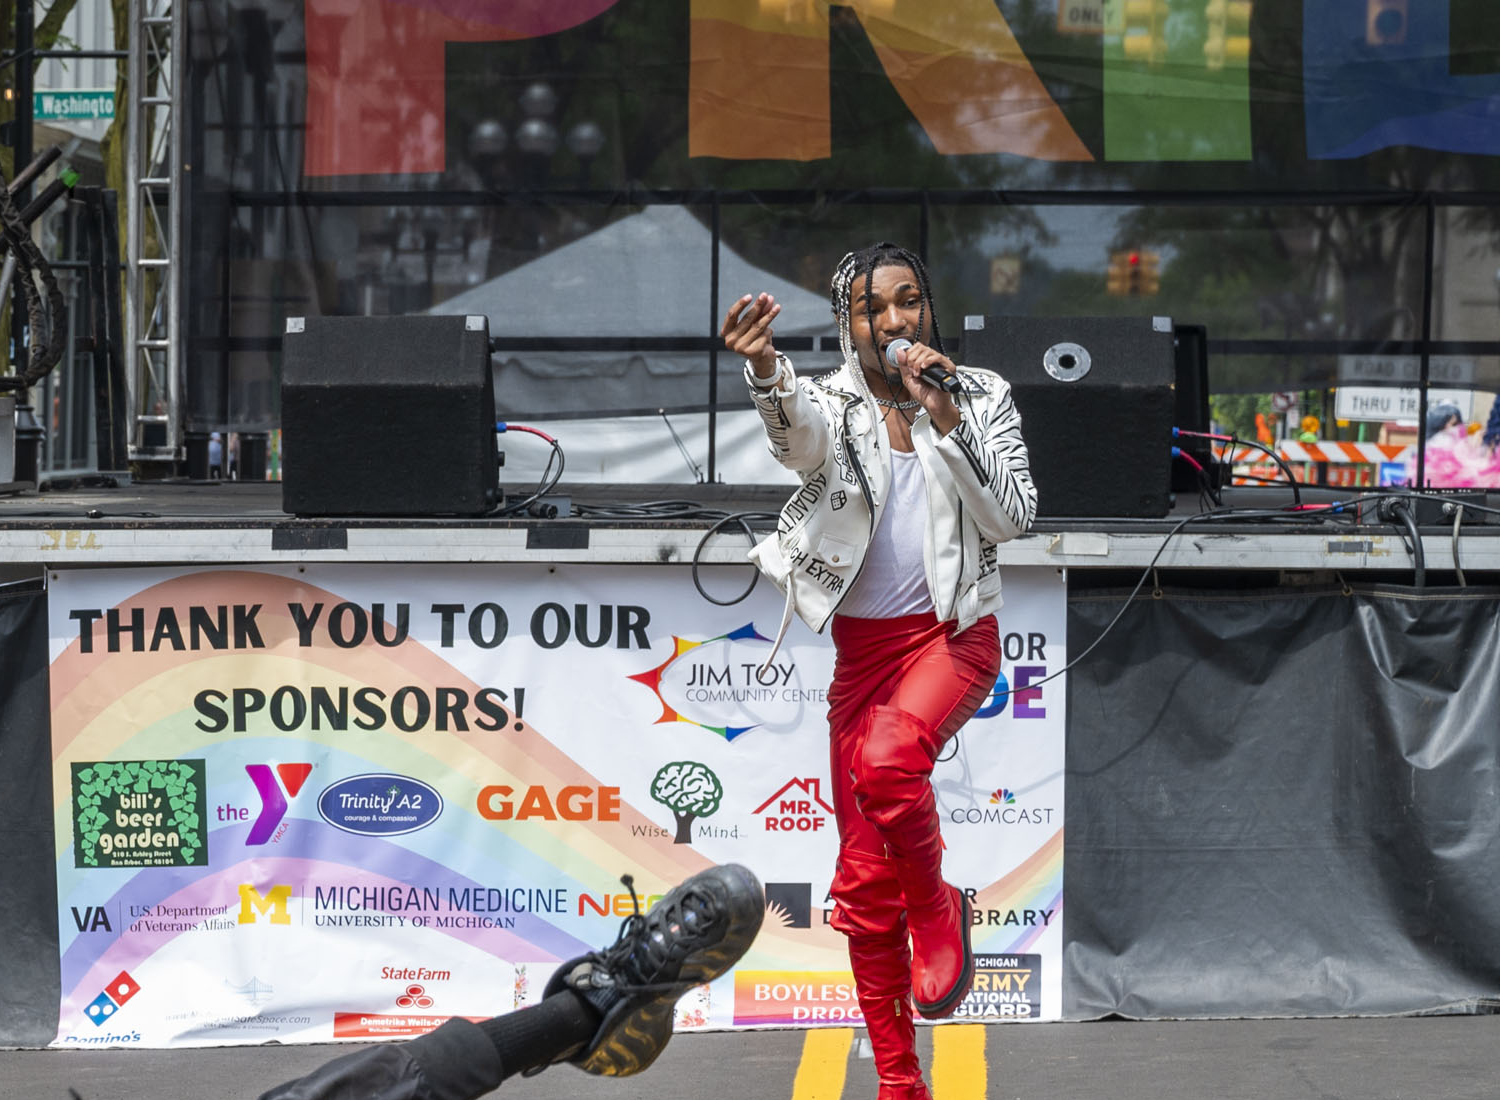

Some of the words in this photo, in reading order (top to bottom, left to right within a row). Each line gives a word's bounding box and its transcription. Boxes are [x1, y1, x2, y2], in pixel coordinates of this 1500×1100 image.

[1069, 6, 1116, 24] ONLY
[42, 94, 114, 118] Washingto
[1403, 361, 1461, 379] CLSED
[1353, 396, 1391, 411] THRU
[805, 557, 845, 595] EXTRA
[69, 604, 266, 654] THANK
[287, 602, 411, 649] YOU
[431, 602, 509, 649] TO
[530, 602, 652, 650] OUR
[1003, 632, 1047, 661] OR
[686, 663, 732, 687] JIM
[741, 663, 796, 687] TOY
[686, 689, 777, 702] COMMUNITY
[782, 689, 830, 702] CENTE
[193, 685, 526, 733] SPONSORS!
[120, 794, 161, 809] bill's
[339, 791, 395, 814] Trinity
[396, 795, 422, 810] A2
[477, 785, 620, 822] GAGE
[780, 800, 817, 814] MR.
[116, 809, 163, 828] beer
[217, 803, 249, 821] the
[344, 814, 371, 822] courage
[378, 814, 418, 822] compassion
[951, 808, 1054, 824] COMCAST
[632, 824, 669, 838] Wise
[698, 824, 739, 839] Mind
[765, 817, 825, 831] ROOF
[99, 828, 179, 854] garden
[272, 823, 290, 845] YMCA
[238, 884, 292, 925] M
[315, 886, 440, 912] MICHIGAN
[448, 887, 567, 913] MEDICINE
[71, 906, 113, 932] VA
[130, 905, 154, 918] U.S.
[156, 904, 228, 921] Department
[315, 915, 407, 927] UNIVERSITY
[412, 915, 430, 927] OF
[435, 916, 516, 928] MICHIGAN
[972, 909, 1054, 927] BRARY
[130, 920, 144, 932] of
[144, 919, 199, 932] Veterans
[201, 917, 236, 931] Affairs
[973, 957, 1018, 968] ICHIGAN
[973, 974, 1031, 992] RMY
[962, 992, 1032, 1003] ATIONAL
[792, 1006, 864, 1021] DRAG
[952, 1004, 1032, 1017] GUARD
